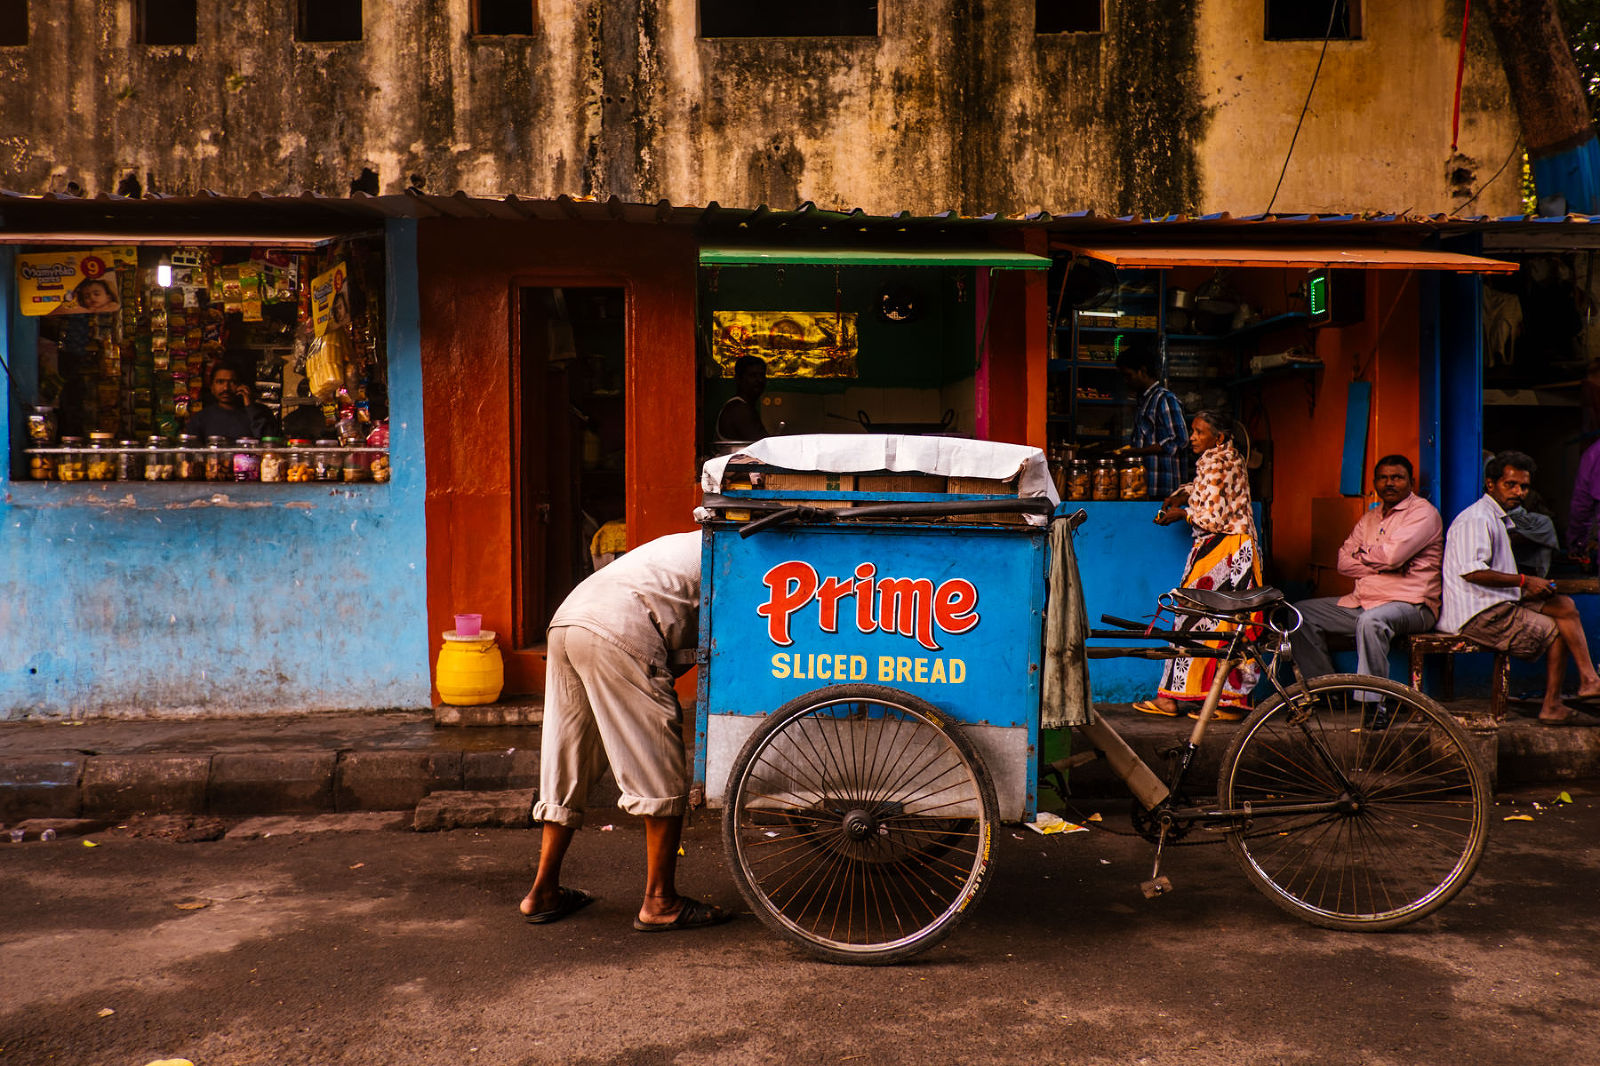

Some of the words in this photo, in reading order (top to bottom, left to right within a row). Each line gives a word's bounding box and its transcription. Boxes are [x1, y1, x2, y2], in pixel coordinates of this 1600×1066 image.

[87, 261, 100, 275] 9
[757, 561, 978, 649] Prime
[772, 653, 867, 680] SLICED
[879, 656, 966, 683] BREAD
